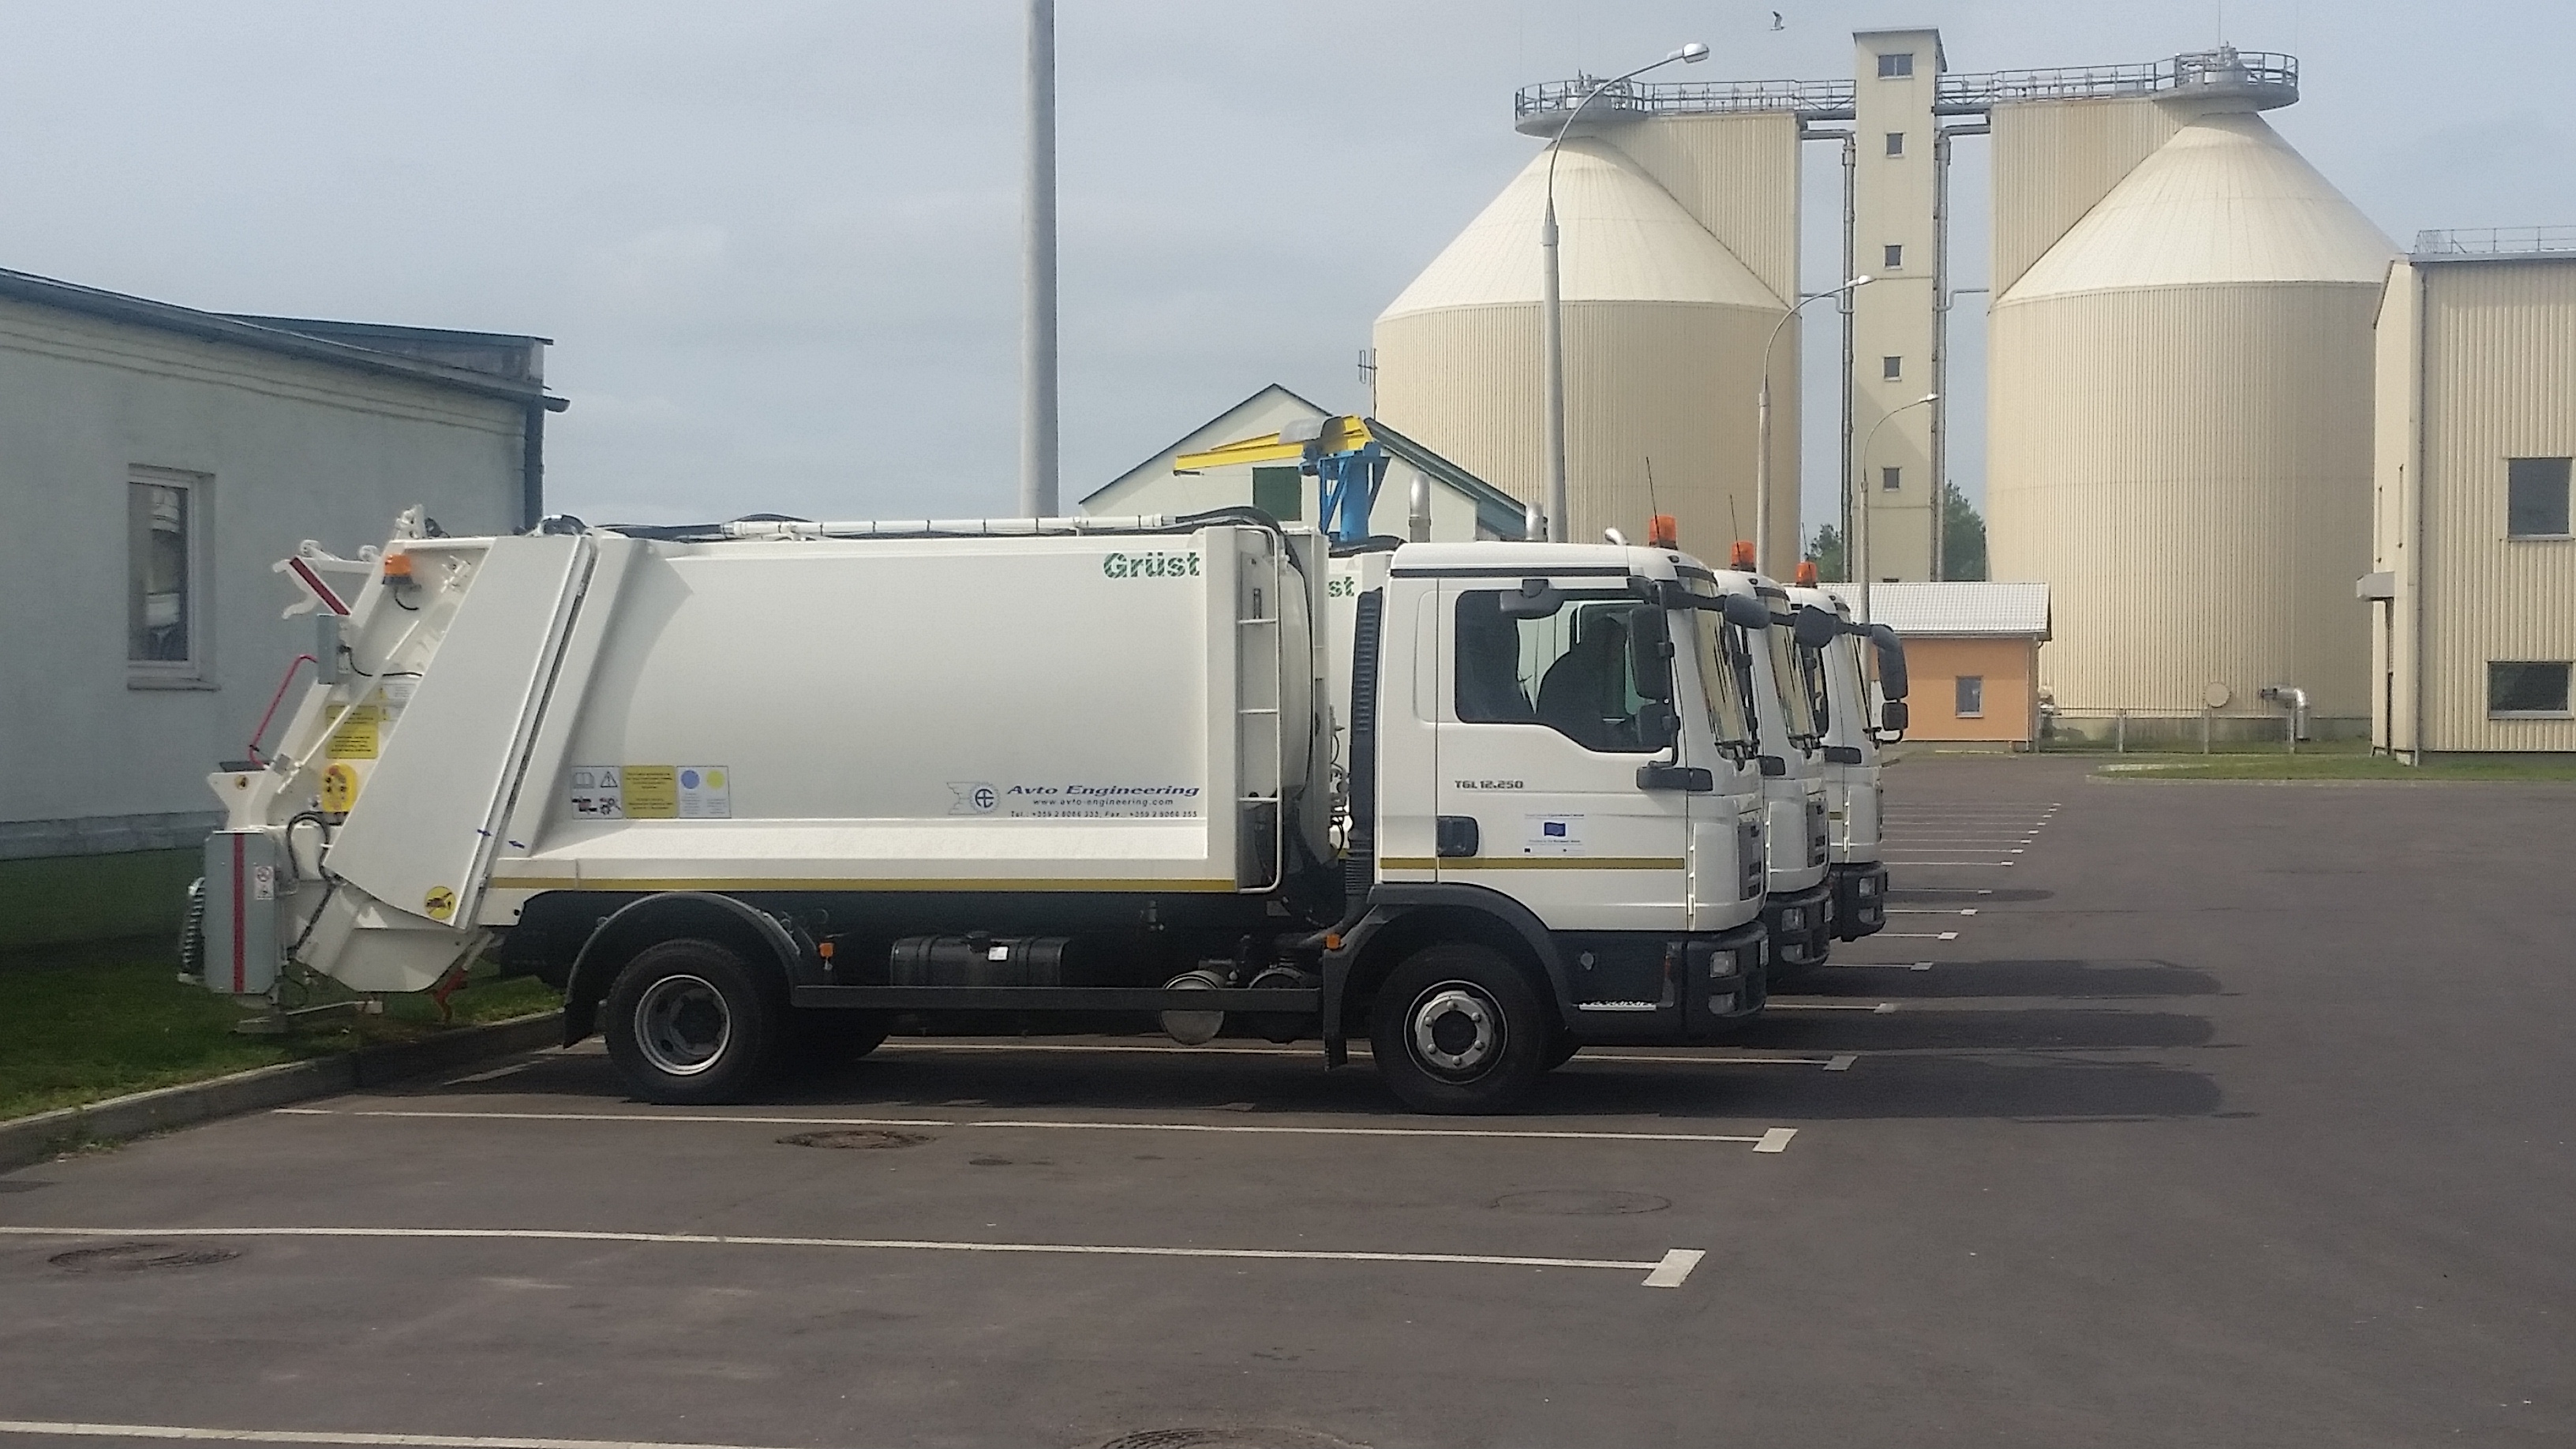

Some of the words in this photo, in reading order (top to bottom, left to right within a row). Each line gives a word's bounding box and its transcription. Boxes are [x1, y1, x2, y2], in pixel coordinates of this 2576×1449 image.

[1103, 552, 1200, 578] Grüst
[1455, 780, 1477, 788] TGL
[1480, 780, 1523, 788] 12.250
[1007, 785, 1058, 795] Avto
[1066, 785, 1200, 797] Engineering
